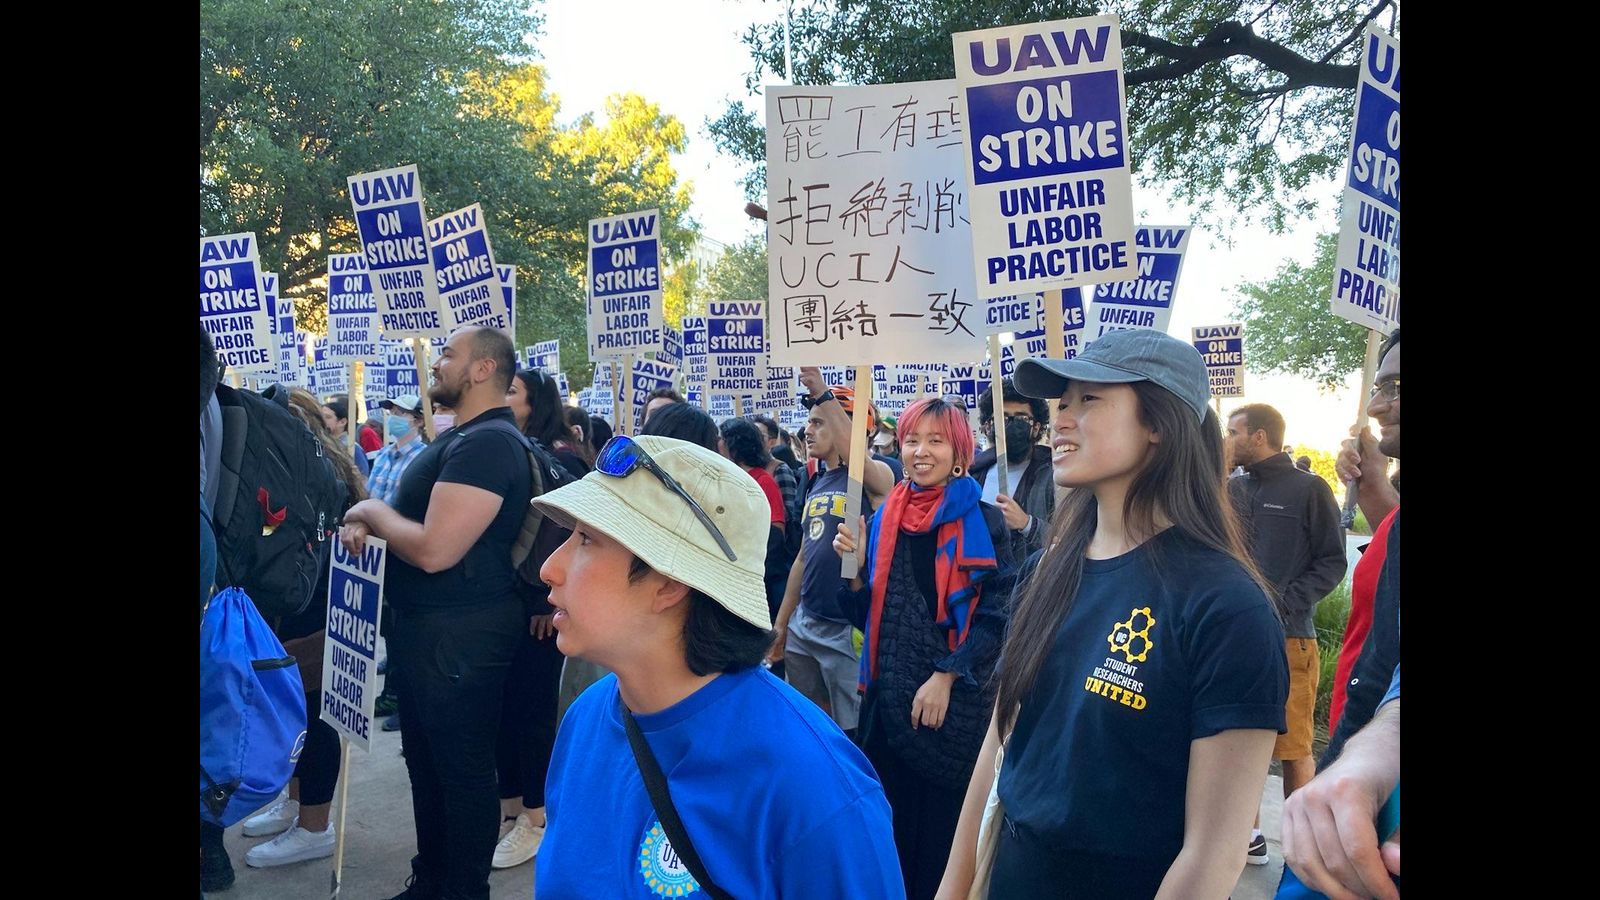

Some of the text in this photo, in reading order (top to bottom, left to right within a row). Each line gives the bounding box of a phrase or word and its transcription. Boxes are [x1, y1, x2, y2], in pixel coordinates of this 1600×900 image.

[970, 25, 1110, 76] UAW
[1016, 80, 1073, 123] ON
[978, 120, 1118, 172] STRIKE
[1354, 142, 1400, 199] STR
[351, 171, 414, 206] UAW
[999, 178, 1105, 217] UNFAIR
[377, 210, 402, 236] ON
[428, 208, 477, 242] UAW
[592, 214, 656, 243] UAW
[1008, 212, 1103, 249] LABOR
[1358, 201, 1400, 247] UNFA
[1135, 228, 1186, 248] AW
[201, 237, 250, 262] AW
[368, 235, 427, 266] STRIKE
[445, 238, 470, 263] ON
[611, 246, 637, 267] ON
[436, 254, 491, 289] STRIKE
[987, 241, 1128, 284] PRACTICE
[1139, 255, 1155, 276] N
[1357, 238, 1400, 286] LABO
[204, 267, 232, 289] ON
[343, 275, 363, 292] ON
[379, 270, 424, 291] UNFAIR
[595, 267, 657, 292] STRIKE
[200, 288, 258, 312] TRIKE
[448, 284, 490, 309] UNFAIR
[1097, 278, 1172, 302] STRIKE
[1337, 268, 1400, 324] PRACTI
[330, 293, 376, 310] STRIKE
[386, 291, 426, 311] LABOR
[603, 294, 650, 314] UNFAIR
[710, 303, 762, 316] UAW
[336, 316, 370, 328] UNFAIR
[382, 311, 440, 331] PRACTICE
[454, 301, 492, 324] LABOR
[606, 313, 648, 330] LABOR
[986, 302, 1030, 324] CTICE
[1099, 308, 1156, 327] UNFAIR
[683, 318, 705, 329] UA
[725, 320, 746, 334] ON
[1195, 326, 1240, 338] UAW
[215, 333, 254, 350] ABOR
[337, 330, 368, 342] LABOR
[598, 329, 660, 349] PRACTICE
[710, 336, 762, 350] STRIKE
[1027, 333, 1078, 353] UNIR
[1208, 340, 1227, 352] ON
[219, 348, 269, 367] ACTICE
[330, 344, 375, 356] PRACTICE
[536, 342, 557, 354] UAW
[685, 342, 706, 355] STRI
[1203, 352, 1241, 364] TRIKE
[717, 356, 756, 366] UNFAIR
[397, 370, 413, 383] ON
[719, 367, 754, 378] LABOR
[767, 367, 793, 379] RIKE
[822, 371, 843, 385] TICE
[1208, 368, 1236, 377] NFAIR
[1210, 377, 1234, 386] ABOR
[637, 378, 658, 392] ON
[711, 379, 763, 389] PRACTICE
[890, 383, 938, 394] PRACCE
[1211, 386, 1242, 395] ACTICE
[756, 399, 795, 410] PRACTICE
[875, 400, 905, 408] PRACTICE
[344, 578, 363, 611] ON
[330, 605, 375, 652] STRIKE
[1116, 631, 1128, 644] UC
[332, 644, 367, 684] UNFAIR
[1103, 657, 1138, 677] STUDENT
[332, 670, 363, 709] LABOR
[1093, 666, 1144, 693] RESEARCHERS
[1084, 676, 1147, 710] UNITED
[324, 690, 368, 741] PRACTICE
[663, 843, 678, 869] UA
